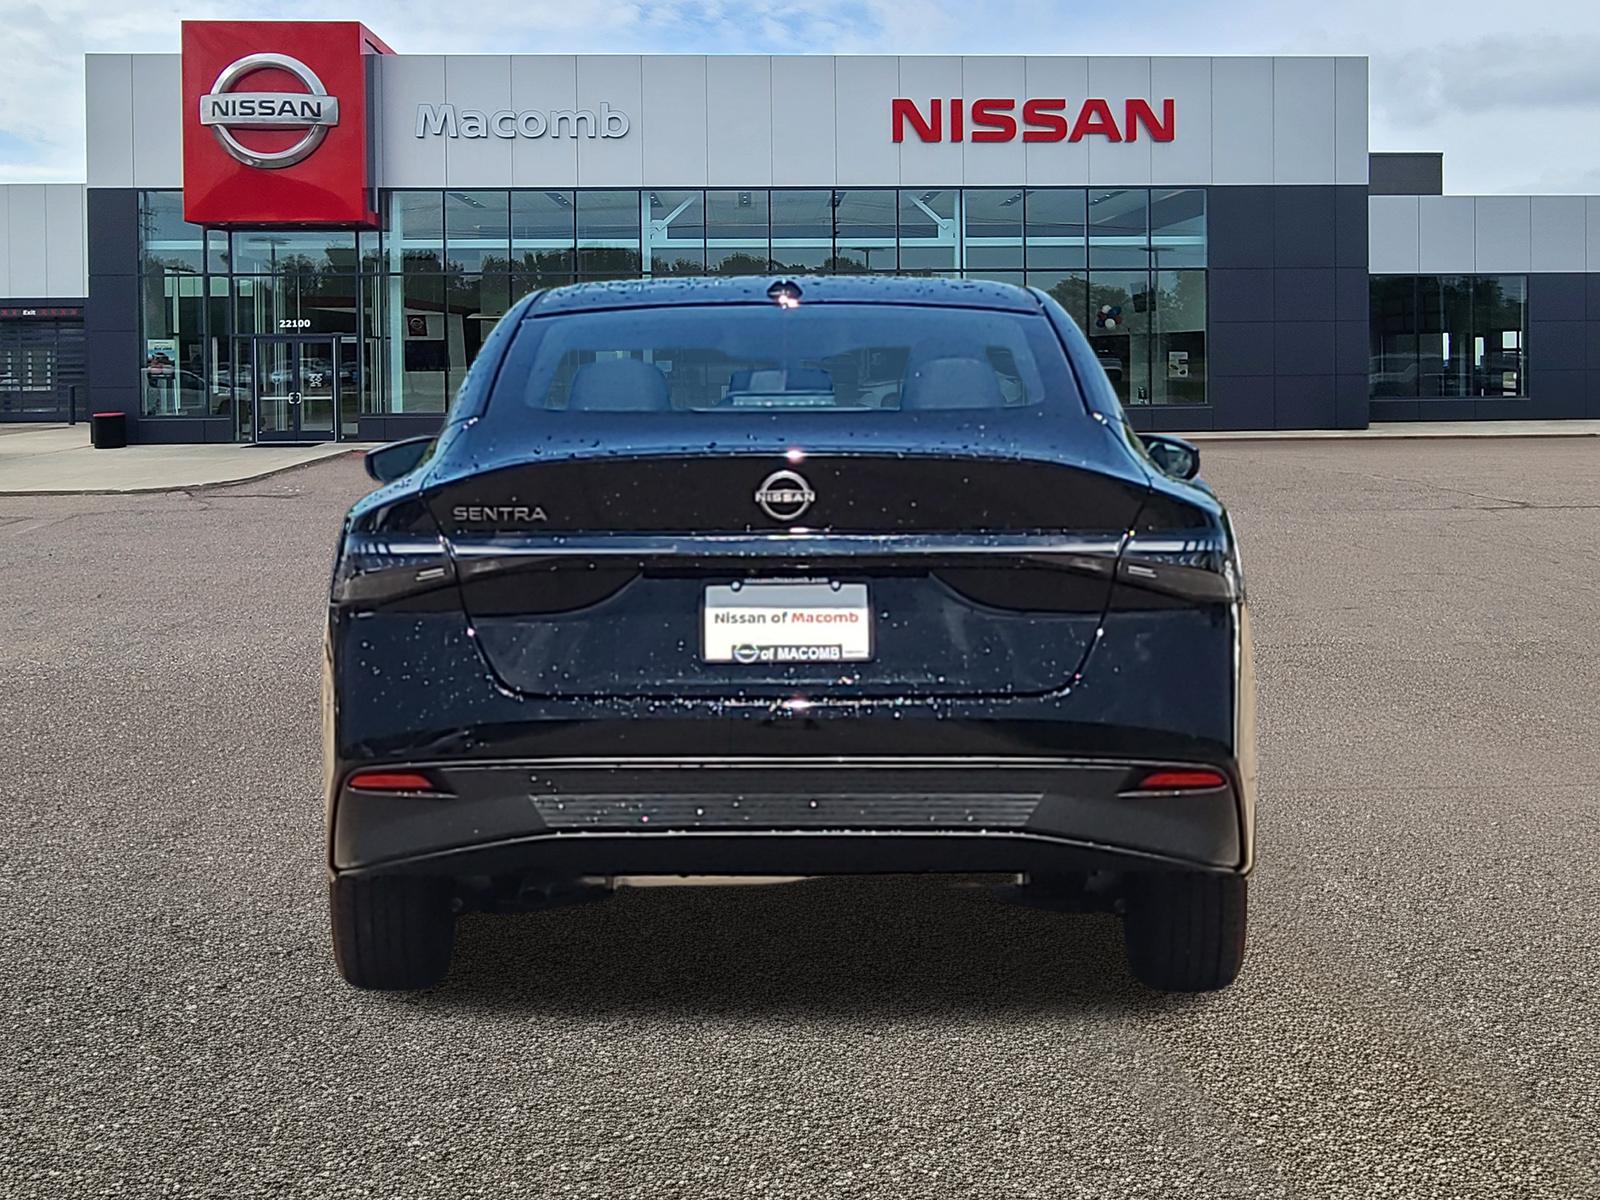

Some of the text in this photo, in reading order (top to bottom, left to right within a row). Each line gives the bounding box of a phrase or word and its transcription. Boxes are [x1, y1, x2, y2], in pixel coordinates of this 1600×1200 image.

[211, 100, 322, 118] NISSAN
[415, 102, 630, 139] Macomb
[892, 98, 1176, 143] NISSAN
[279, 319, 311, 328] 22100
[755, 490, 815, 503] NISSAN
[453, 506, 548, 522] SENTRA
[714, 611, 859, 624] Nissan of Macomb
[760, 647, 840, 661] of MACOMB
